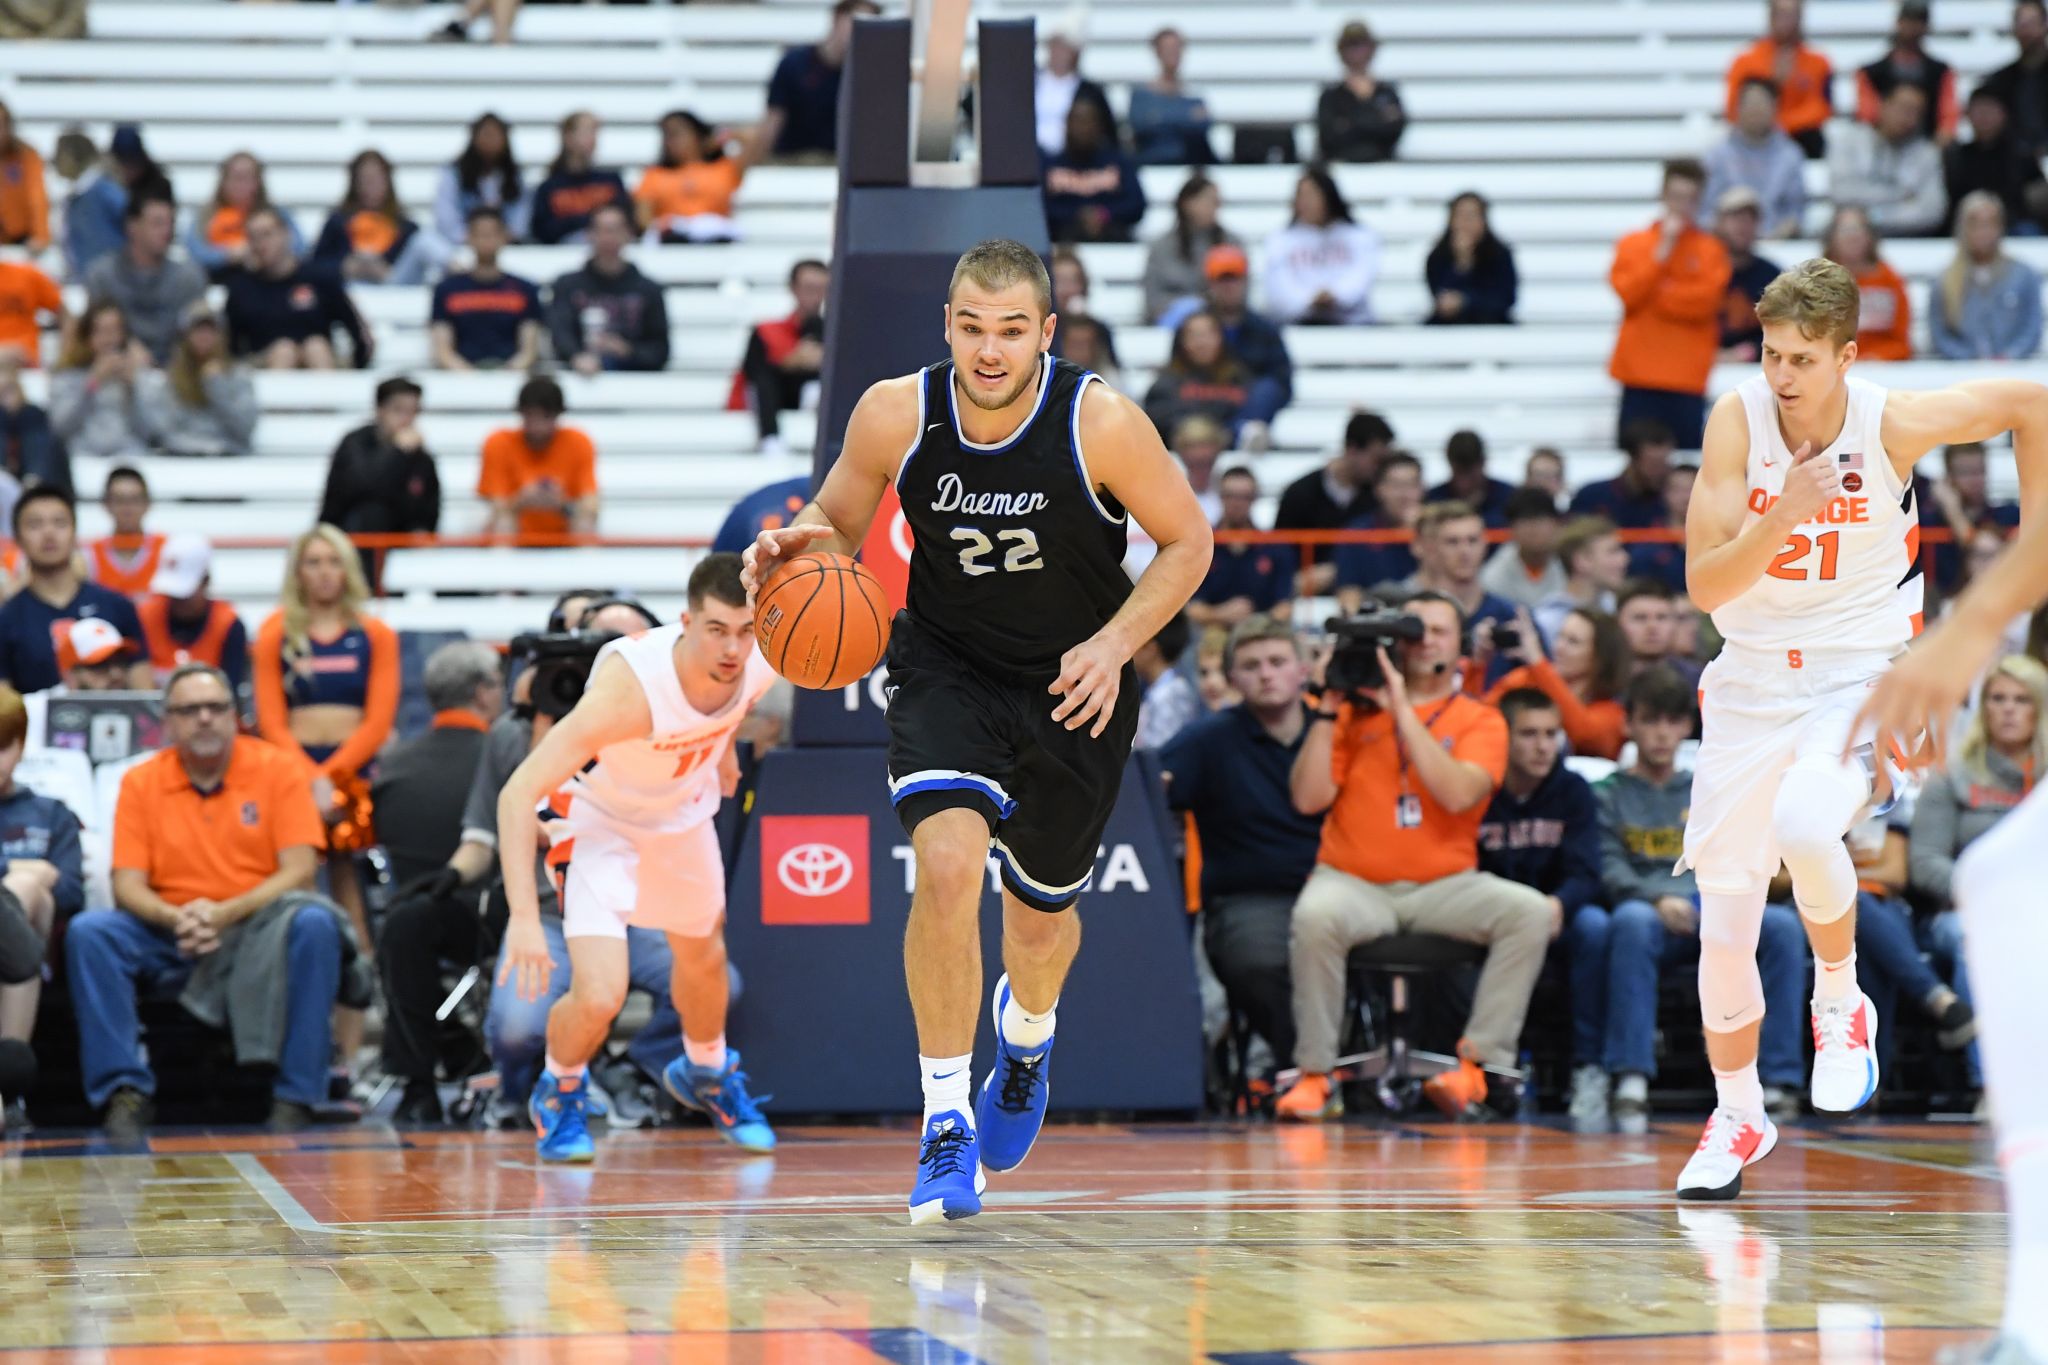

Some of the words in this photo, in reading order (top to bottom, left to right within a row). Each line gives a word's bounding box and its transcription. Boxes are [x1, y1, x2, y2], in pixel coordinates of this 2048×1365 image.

[931, 473, 1049, 515] Daemen
[949, 526, 1044, 576] 22
[1765, 531, 1840, 580] 21
[1787, 649, 1802, 668] S
[672, 745, 714, 779] 11
